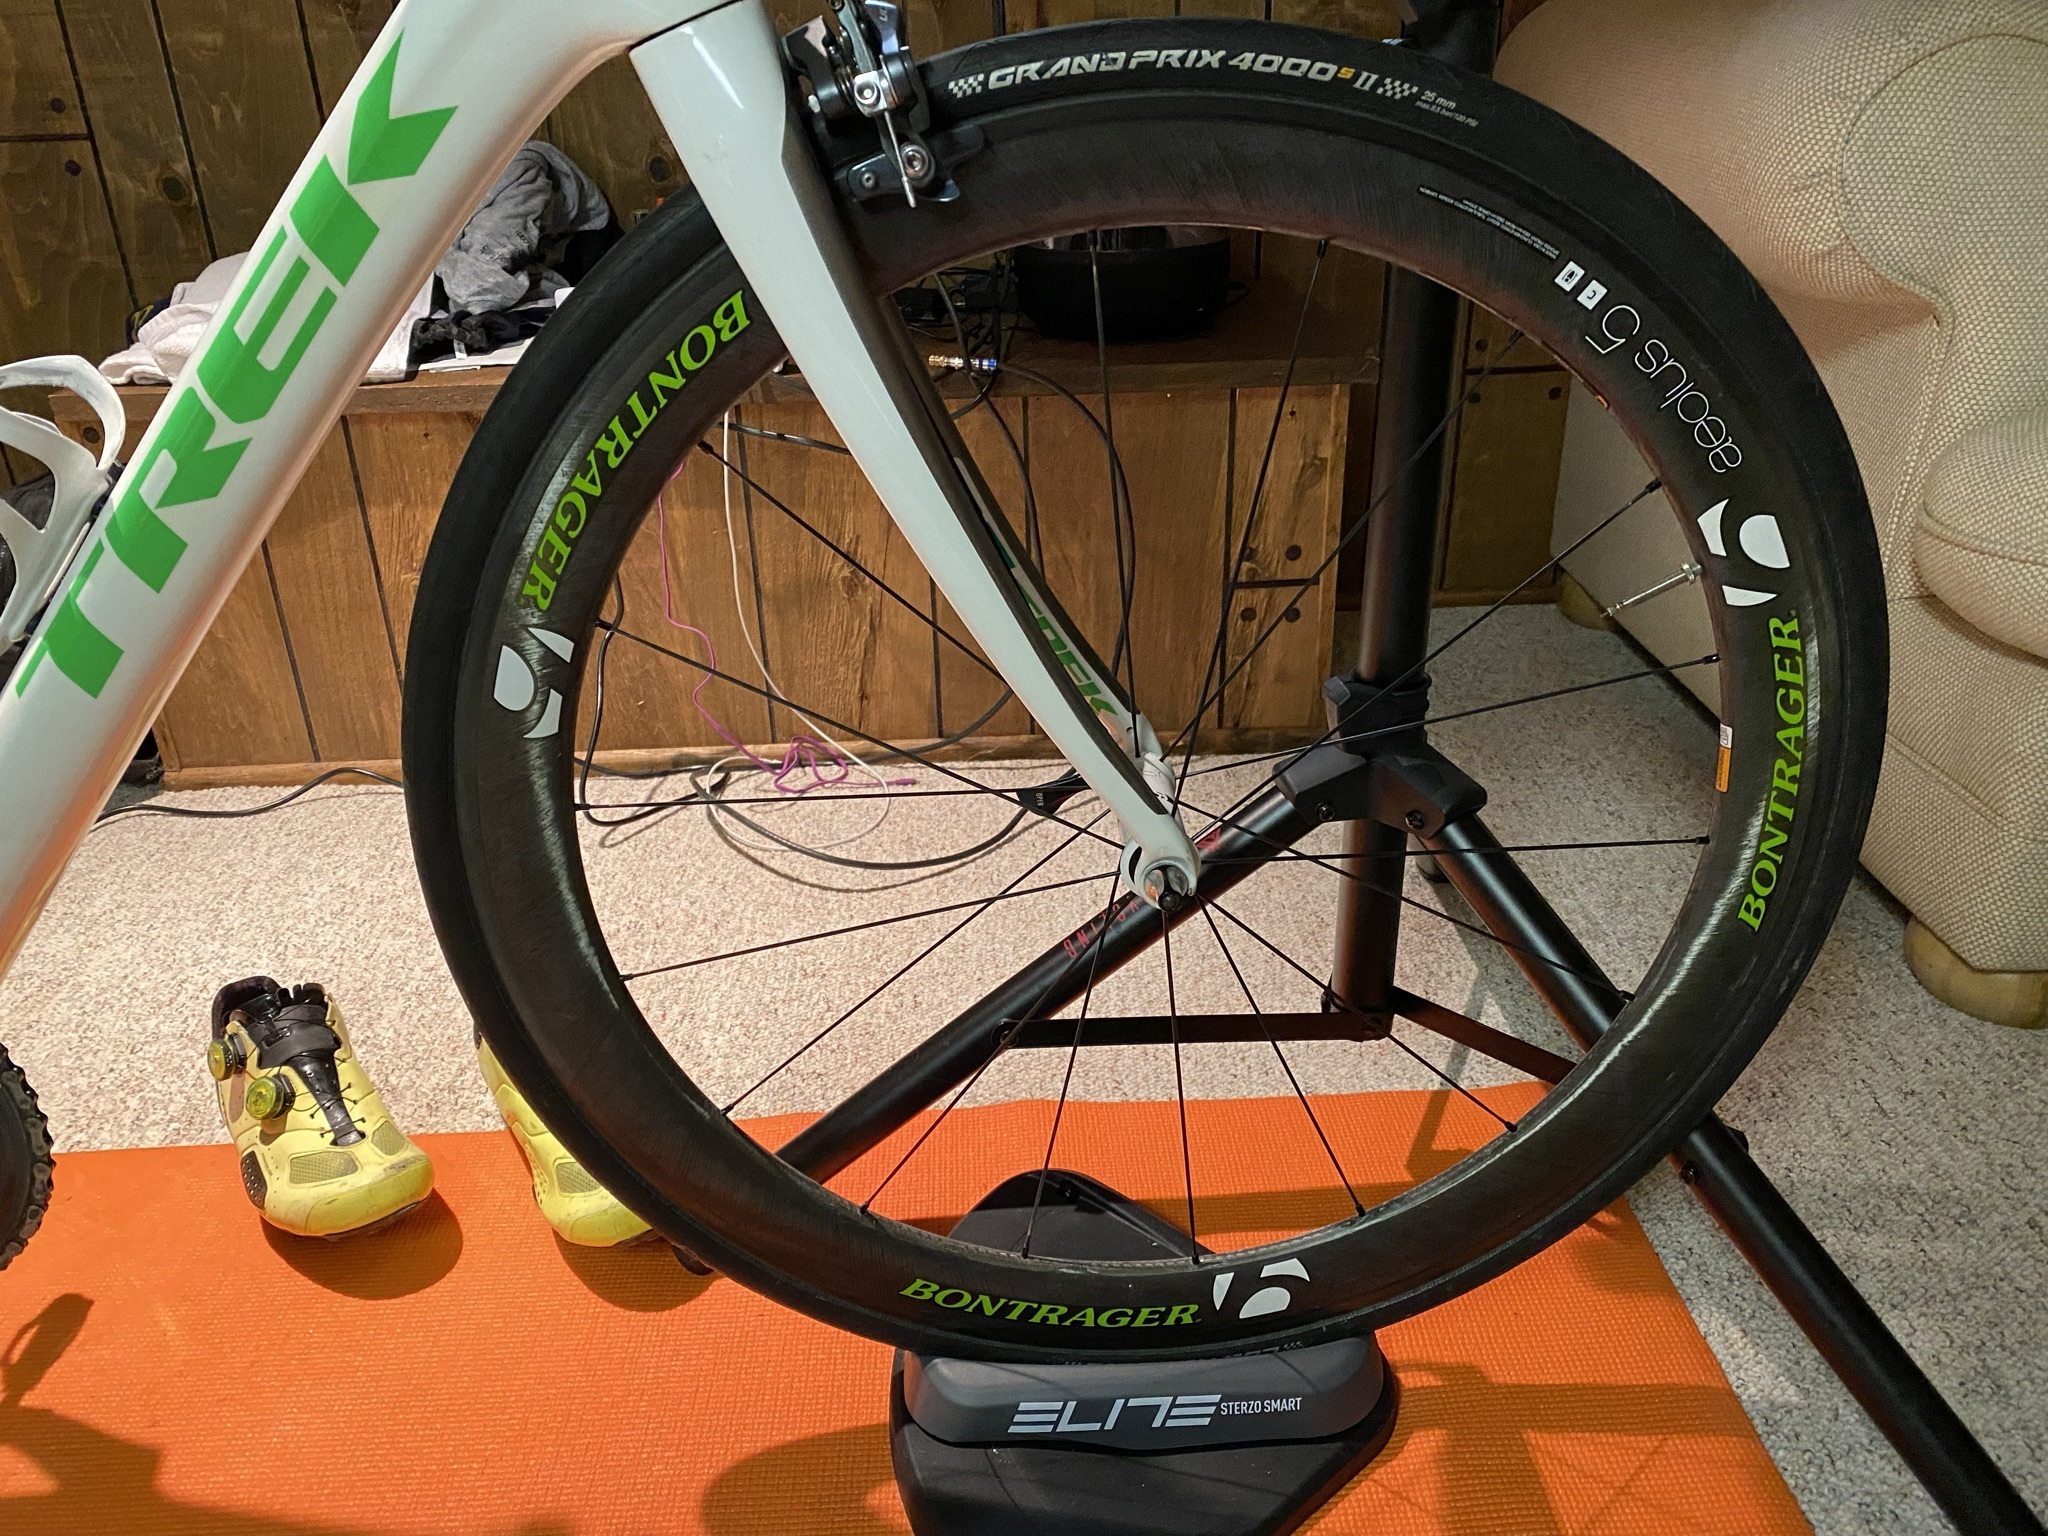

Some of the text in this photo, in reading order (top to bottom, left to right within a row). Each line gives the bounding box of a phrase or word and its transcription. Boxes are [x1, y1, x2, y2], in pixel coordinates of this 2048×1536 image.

[988, 51, 1127, 90] GRAND
[1127, 49, 1227, 70] PRIX
[1435, 97, 1456, 110] mm
[15, 28, 459, 699] TREK
[1585, 304, 1742, 473] aeolus 5
[522, 290, 750, 611] BONTRAGER
[1016, 582, 1119, 716] REK
[1035, 792, 1045, 807] OPEN
[1738, 615, 1805, 932] BONTRAGER
[899, 1278, 1201, 1328] BONTRAGER
[1008, 1394, 1303, 1433] ELITE STERZO SMART
